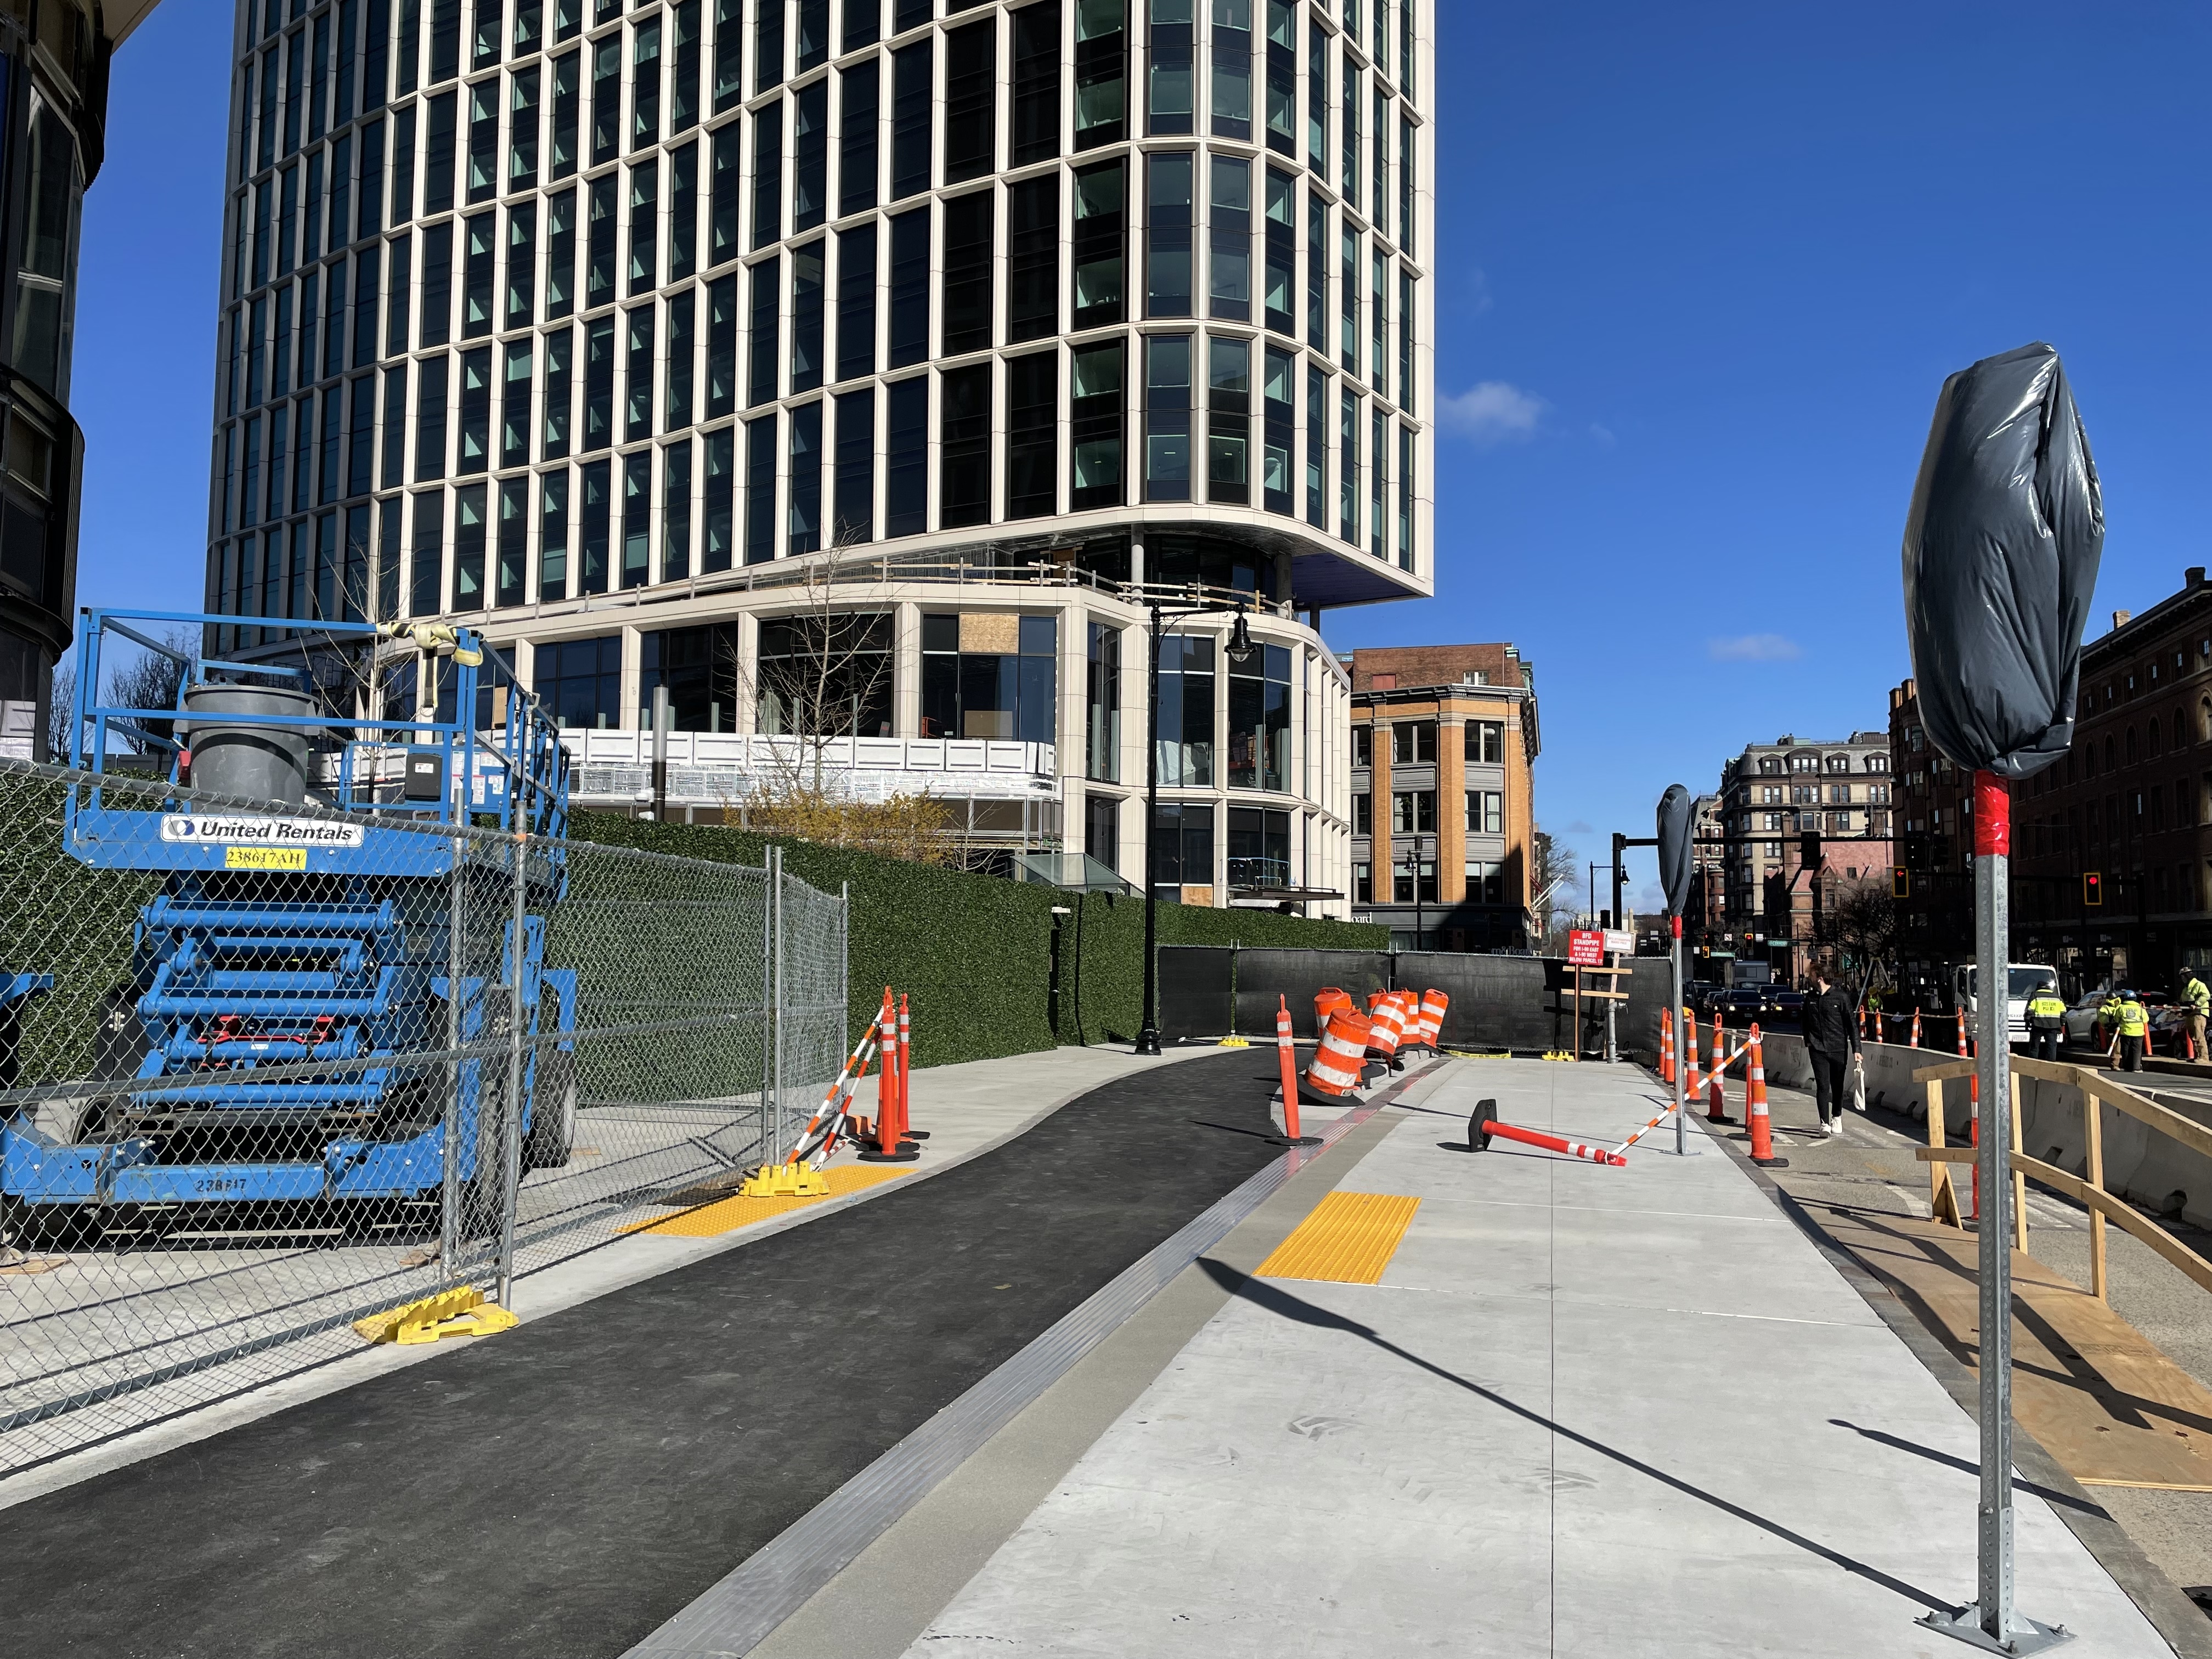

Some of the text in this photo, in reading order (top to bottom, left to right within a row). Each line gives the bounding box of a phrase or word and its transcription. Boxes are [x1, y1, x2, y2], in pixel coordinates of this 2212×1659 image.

[200, 821, 353, 840] United Rentals
[226, 851, 300, 864] 238617AH
